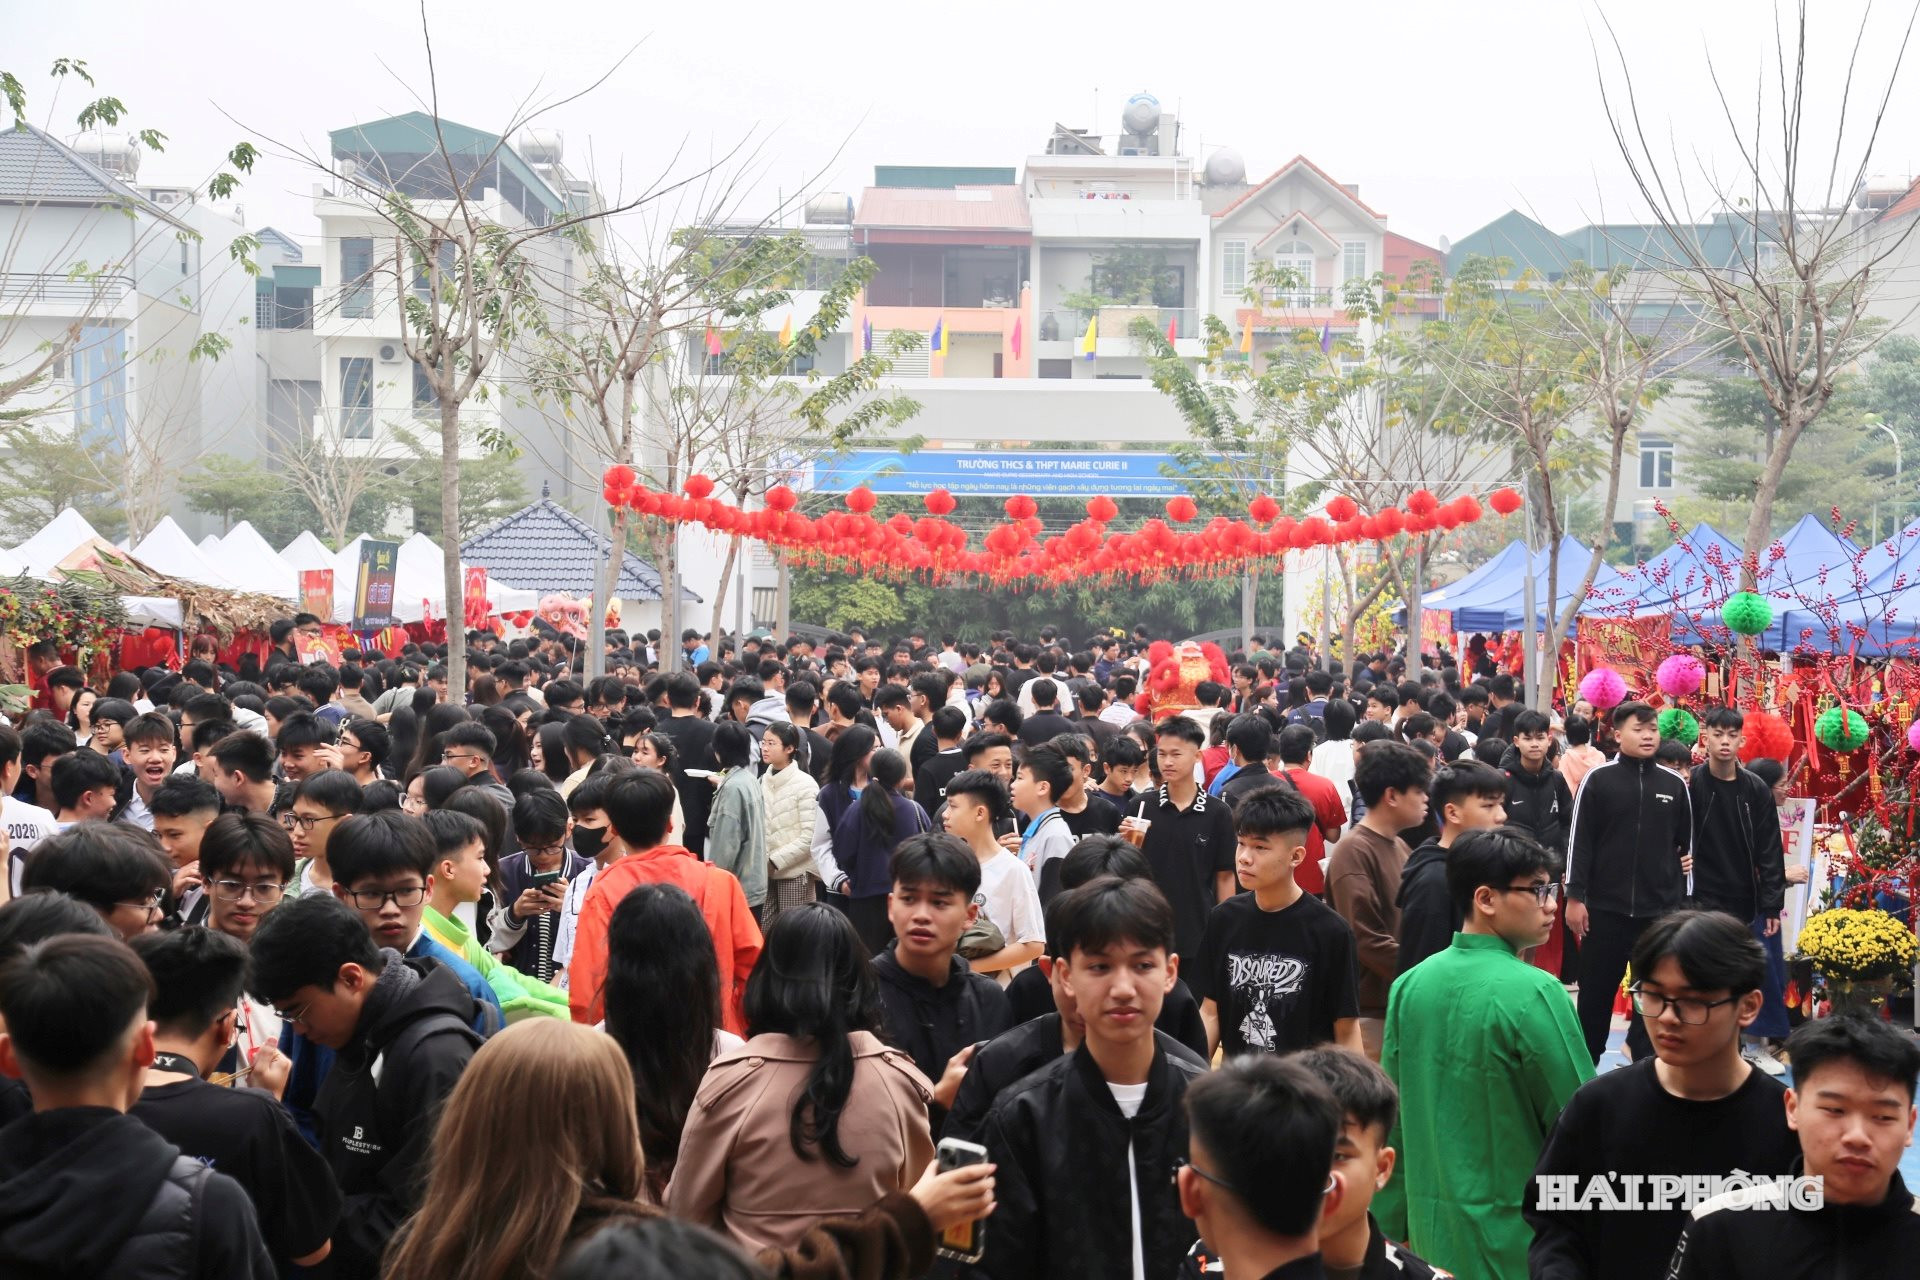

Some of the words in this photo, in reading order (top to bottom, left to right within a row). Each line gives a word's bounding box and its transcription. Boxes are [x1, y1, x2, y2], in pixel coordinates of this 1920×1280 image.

[957, 458, 998, 469] TRƯỜNG
[1000, 460, 1023, 469] THCS
[1025, 460, 1033, 469] &
[1035, 461, 1058, 470] THPT
[1060, 461, 1090, 470] MARIE
[1092, 461, 1120, 470] CURIE
[1121, 461, 1128, 470] II
[960, 482, 978, 491] ngày
[996, 484, 1010, 492] nay
[1058, 484, 1075, 492] gạch
[1077, 484, 1090, 492] xây
[1143, 485, 1161, 493] ngày
[153, 1055, 177, 1067] NY
